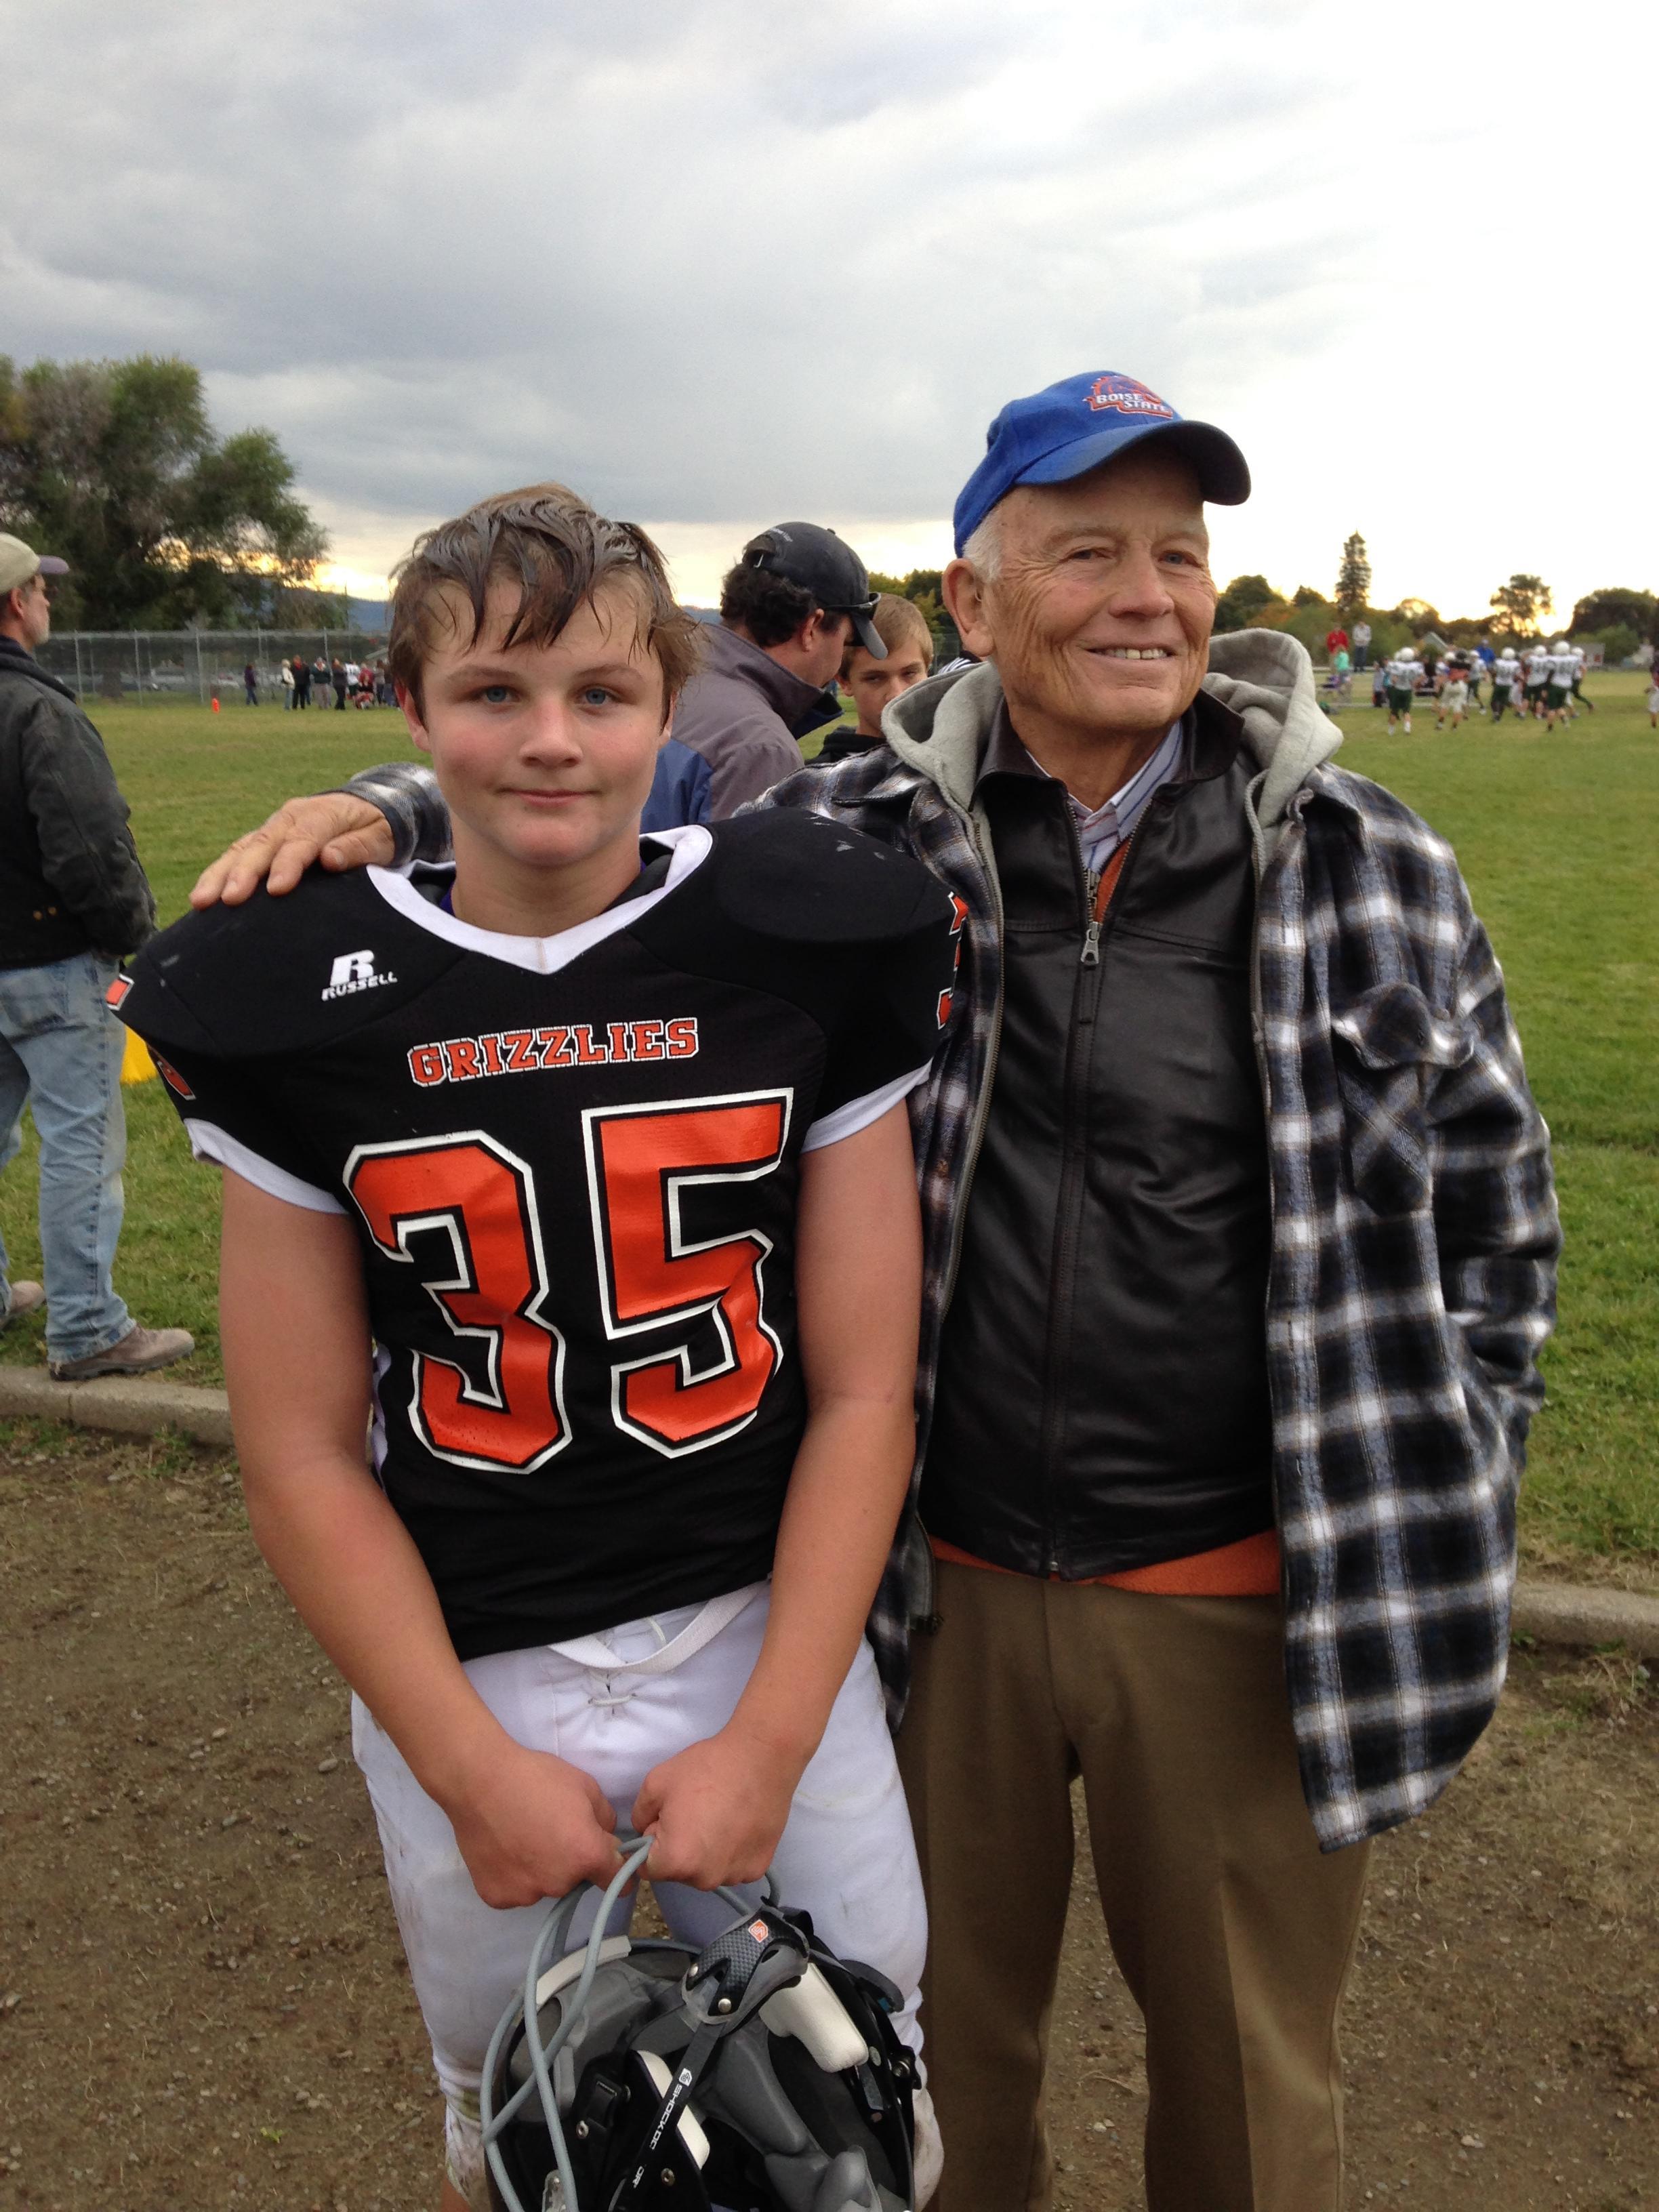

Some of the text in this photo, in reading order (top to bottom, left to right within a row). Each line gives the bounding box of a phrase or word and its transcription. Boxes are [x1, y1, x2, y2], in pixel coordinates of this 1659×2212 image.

[1096, 393, 1143, 403] BOISE
[1124, 401, 1169, 413] STATE
[321, 971, 398, 1002] RUSSELL
[407, 1017, 699, 1086] GRIZZLIES
[342, 1088, 794, 1475] 35
[657, 2083, 682, 2130] SHOCK
